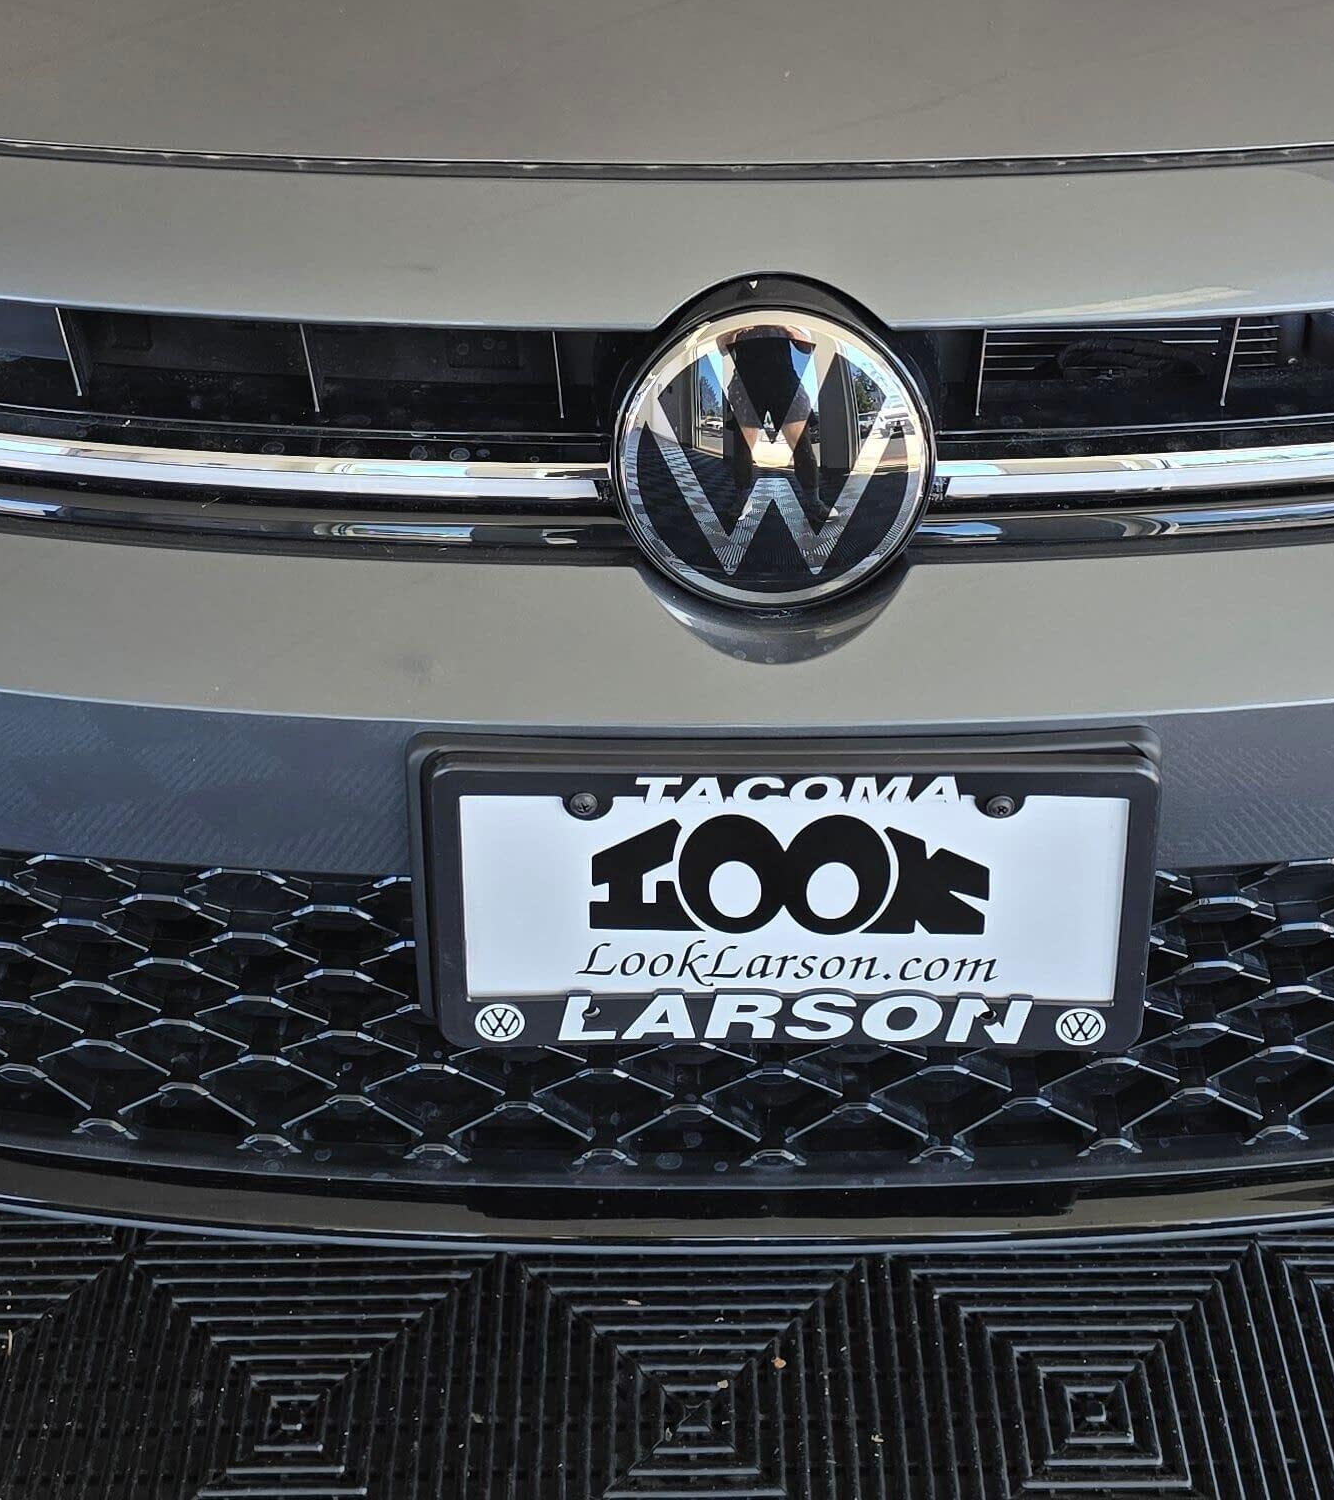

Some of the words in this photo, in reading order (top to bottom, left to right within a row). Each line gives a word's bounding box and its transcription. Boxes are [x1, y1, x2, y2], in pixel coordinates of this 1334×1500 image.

[636, 776, 964, 803] TACOMA
[589, 814, 991, 935] LOOK
[576, 940, 999, 987] LookLarson.com
[558, 995, 1033, 1045] LARSON
